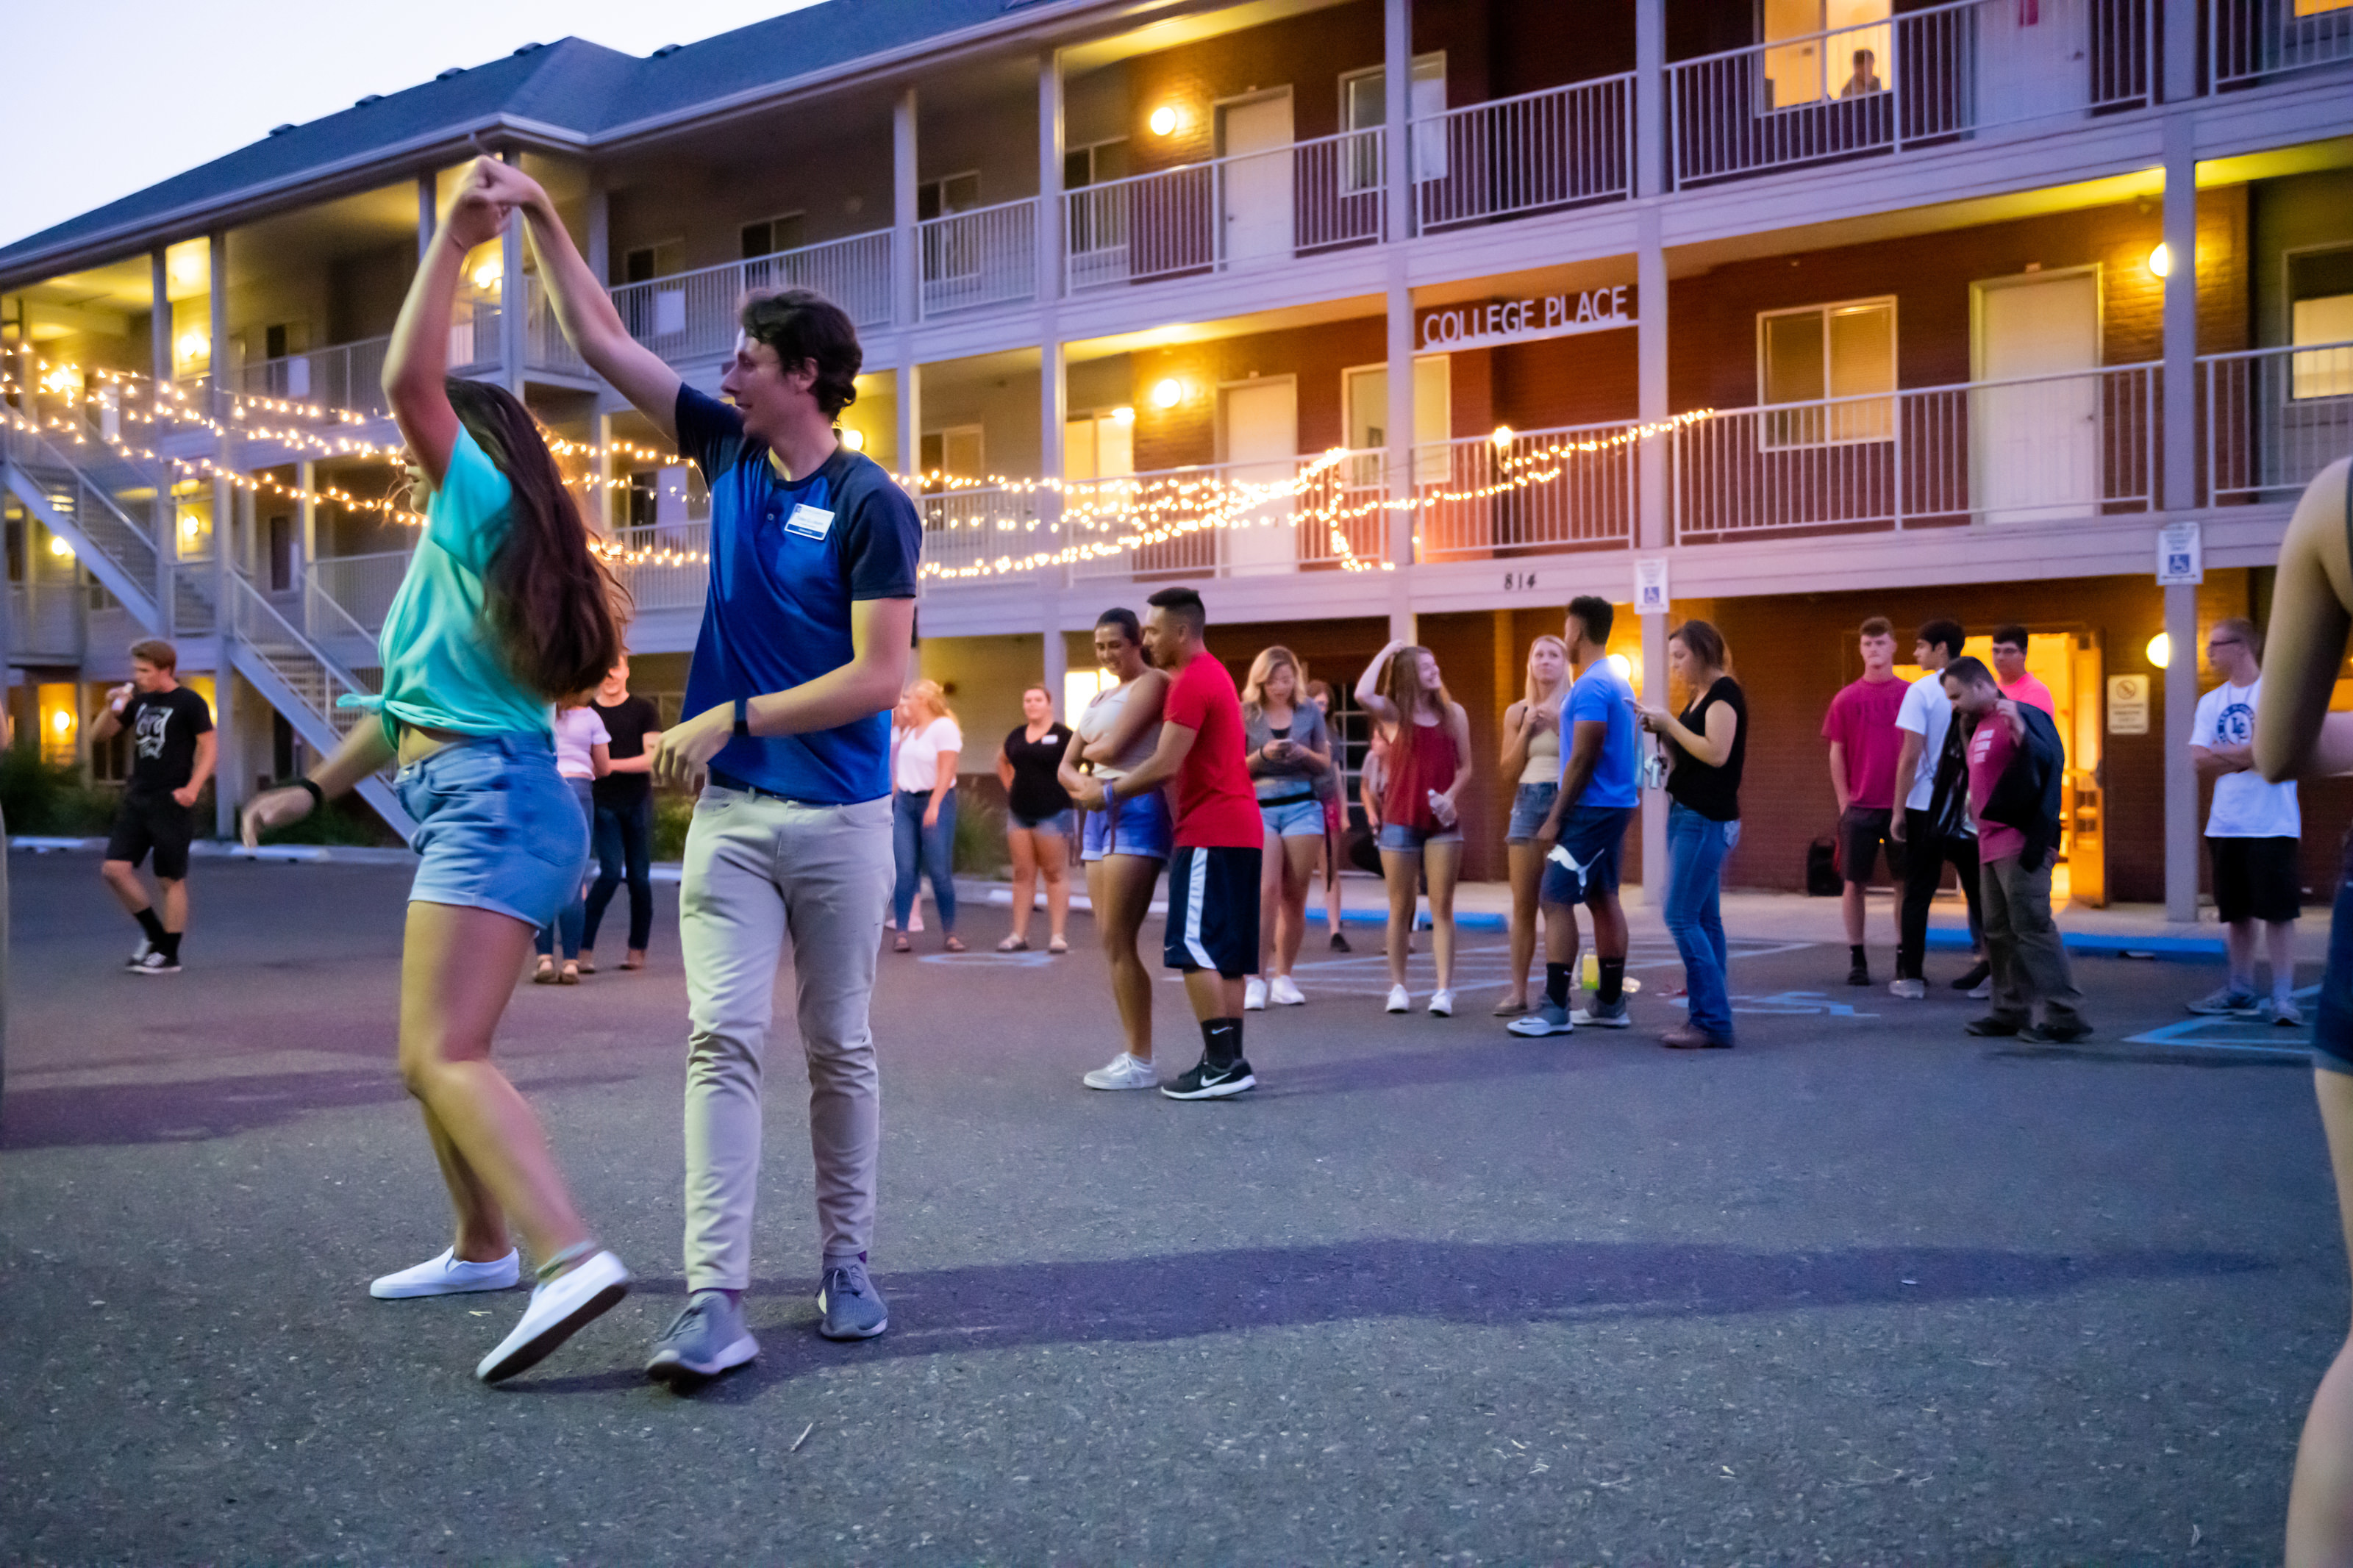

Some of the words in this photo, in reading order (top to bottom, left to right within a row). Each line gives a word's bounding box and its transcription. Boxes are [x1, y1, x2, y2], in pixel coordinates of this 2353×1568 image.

[1423, 300, 1535, 344] COLLEGE
[1546, 285, 1627, 329] PLACE
[1504, 572, 1536, 590] 814
